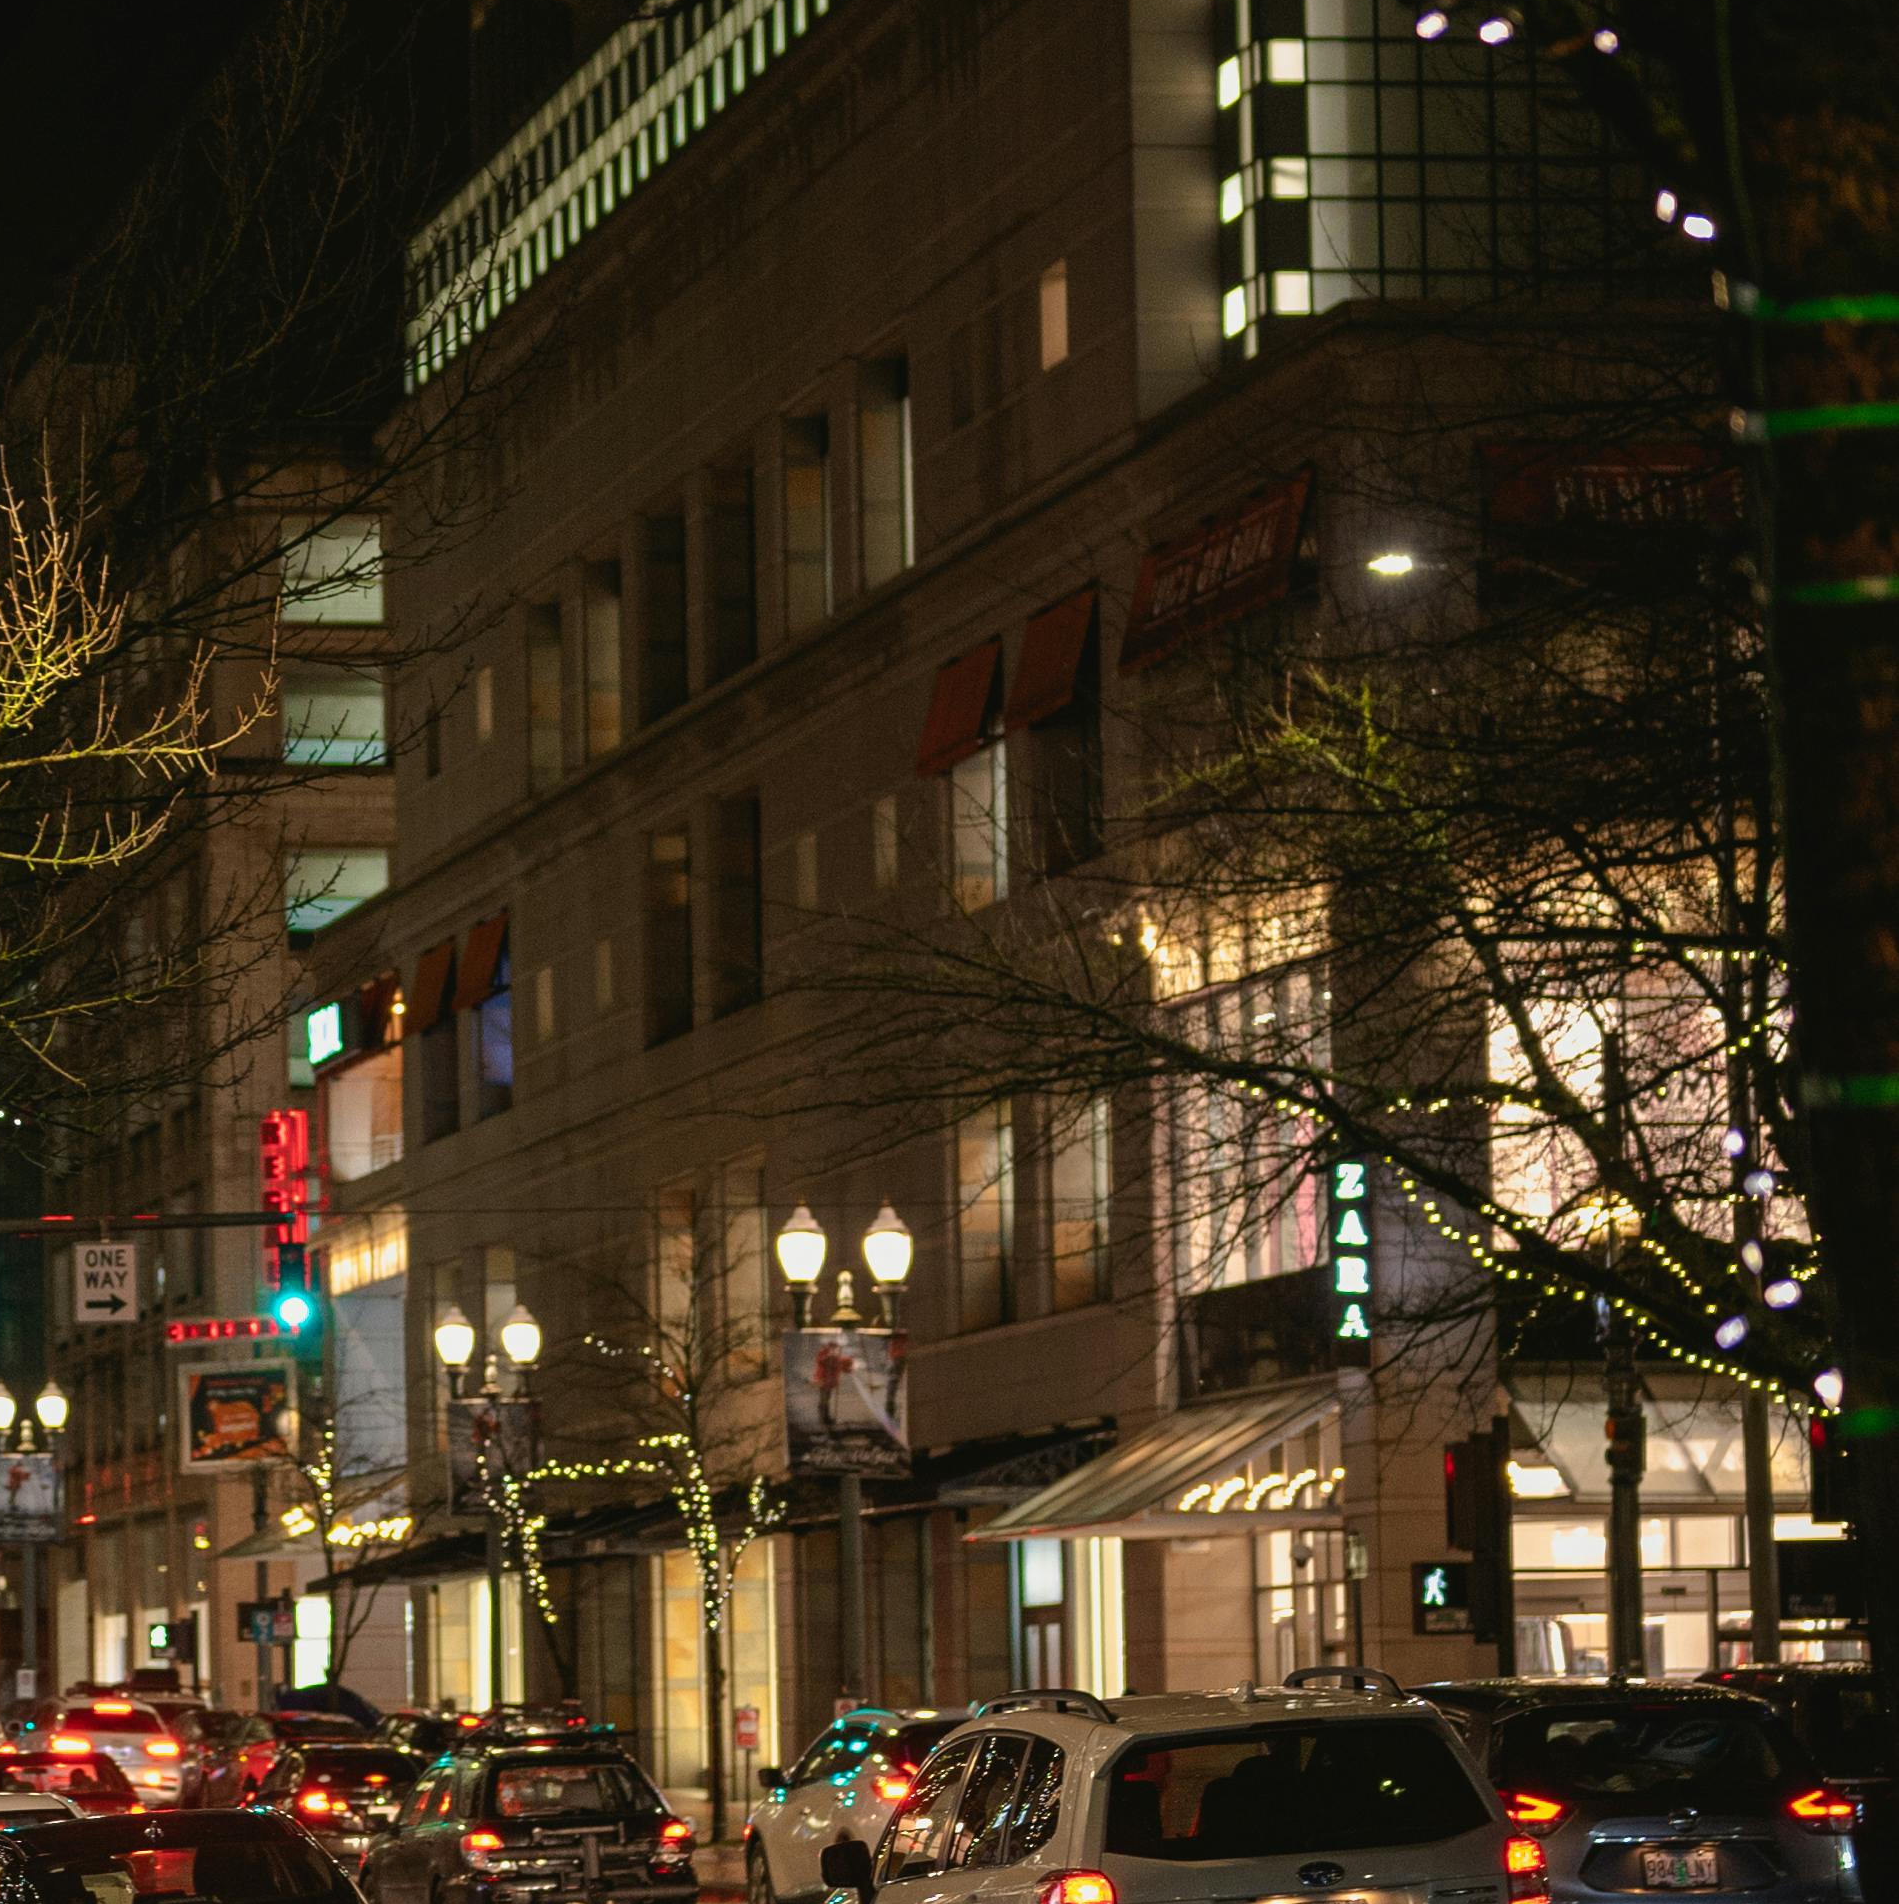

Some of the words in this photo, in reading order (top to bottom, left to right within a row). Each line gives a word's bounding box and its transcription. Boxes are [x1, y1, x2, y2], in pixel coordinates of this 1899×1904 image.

[84, 1249, 127, 1268] ONE
[1335, 1163, 1370, 1338] ZARA
[83, 1270, 129, 1289] WAY
